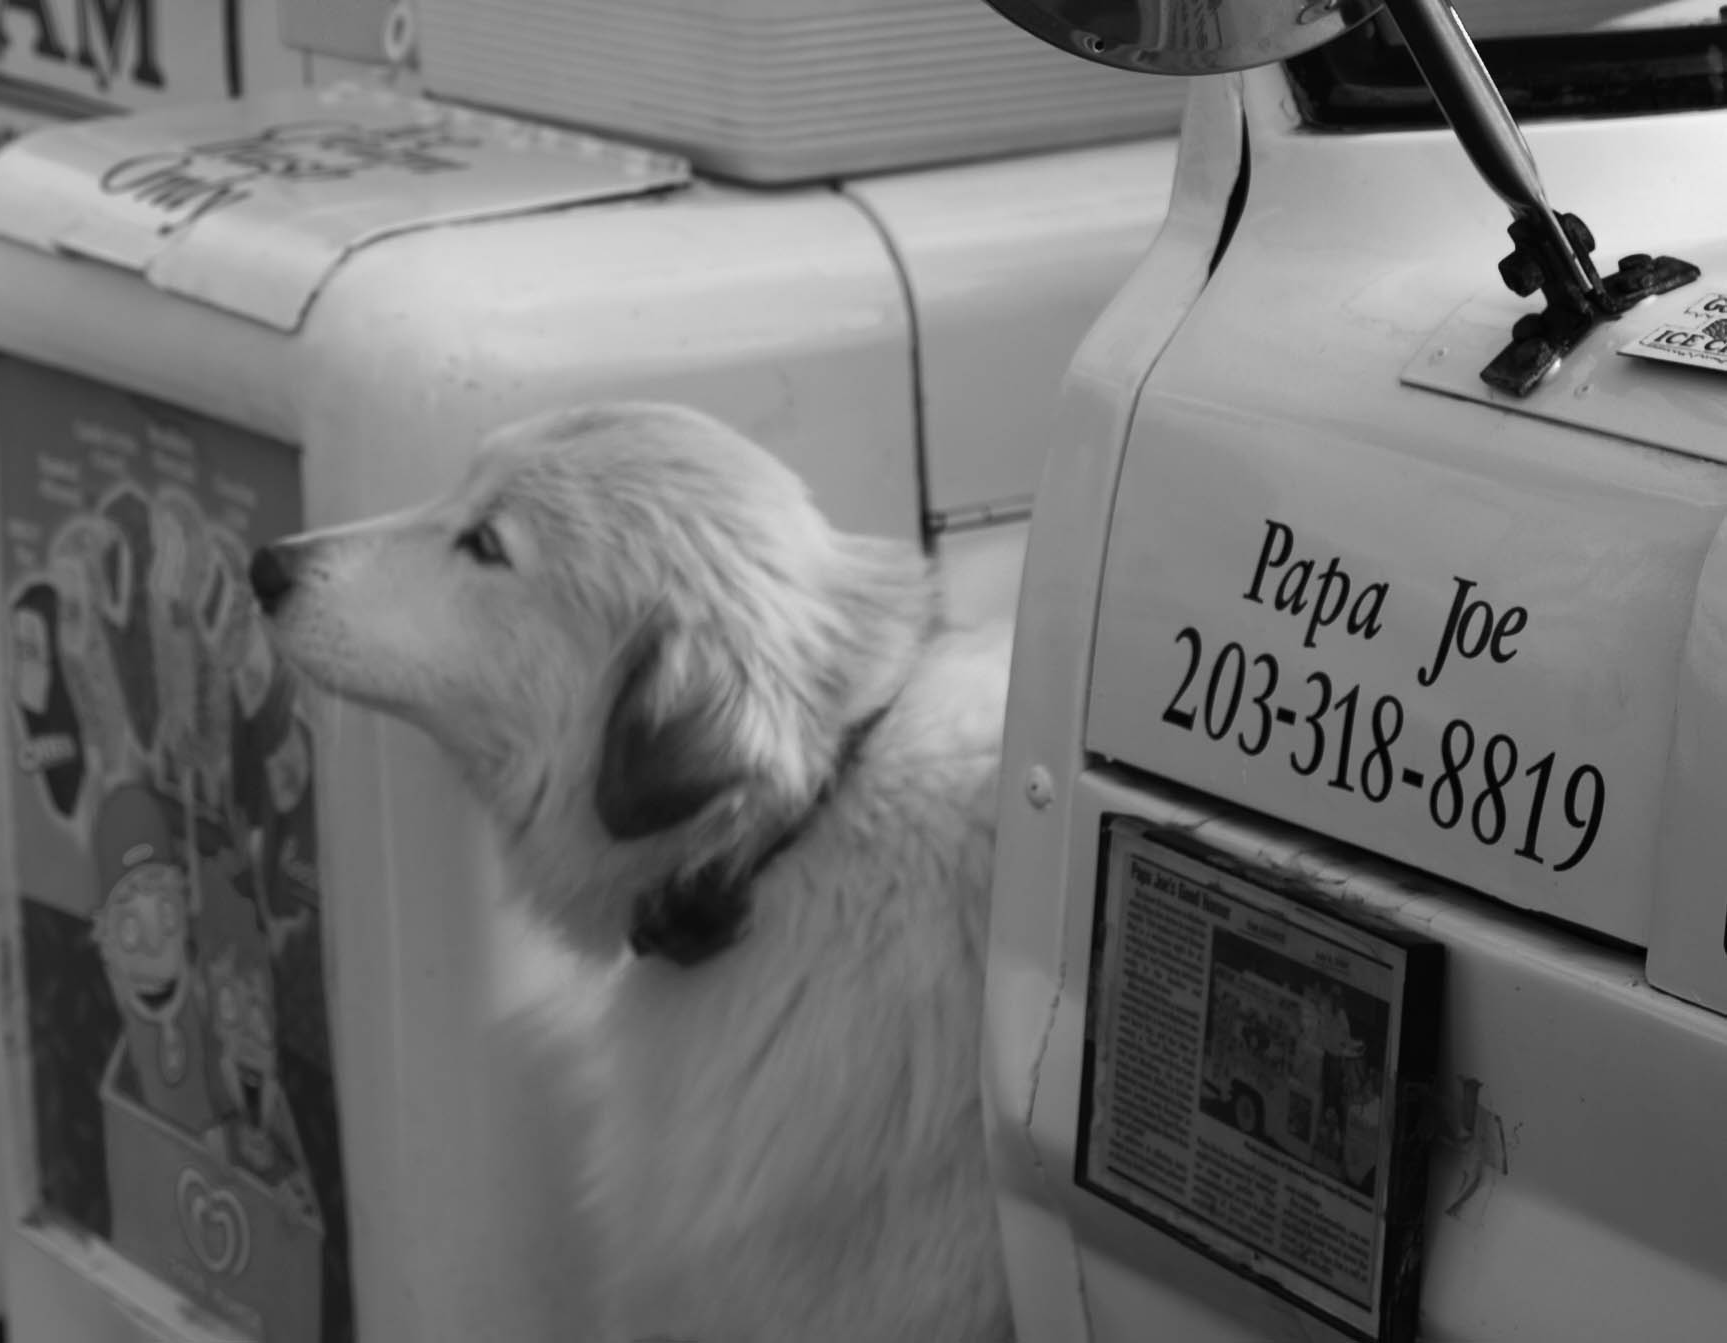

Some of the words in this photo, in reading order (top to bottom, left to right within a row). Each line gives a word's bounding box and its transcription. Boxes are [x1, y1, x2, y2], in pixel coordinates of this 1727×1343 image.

[1653, 329, 1706, 348] ICE
[1242, 519, 1390, 648] Papa
[1417, 576, 1529, 687] Joe
[1162, 626, 1606, 872] 203-318-8819
